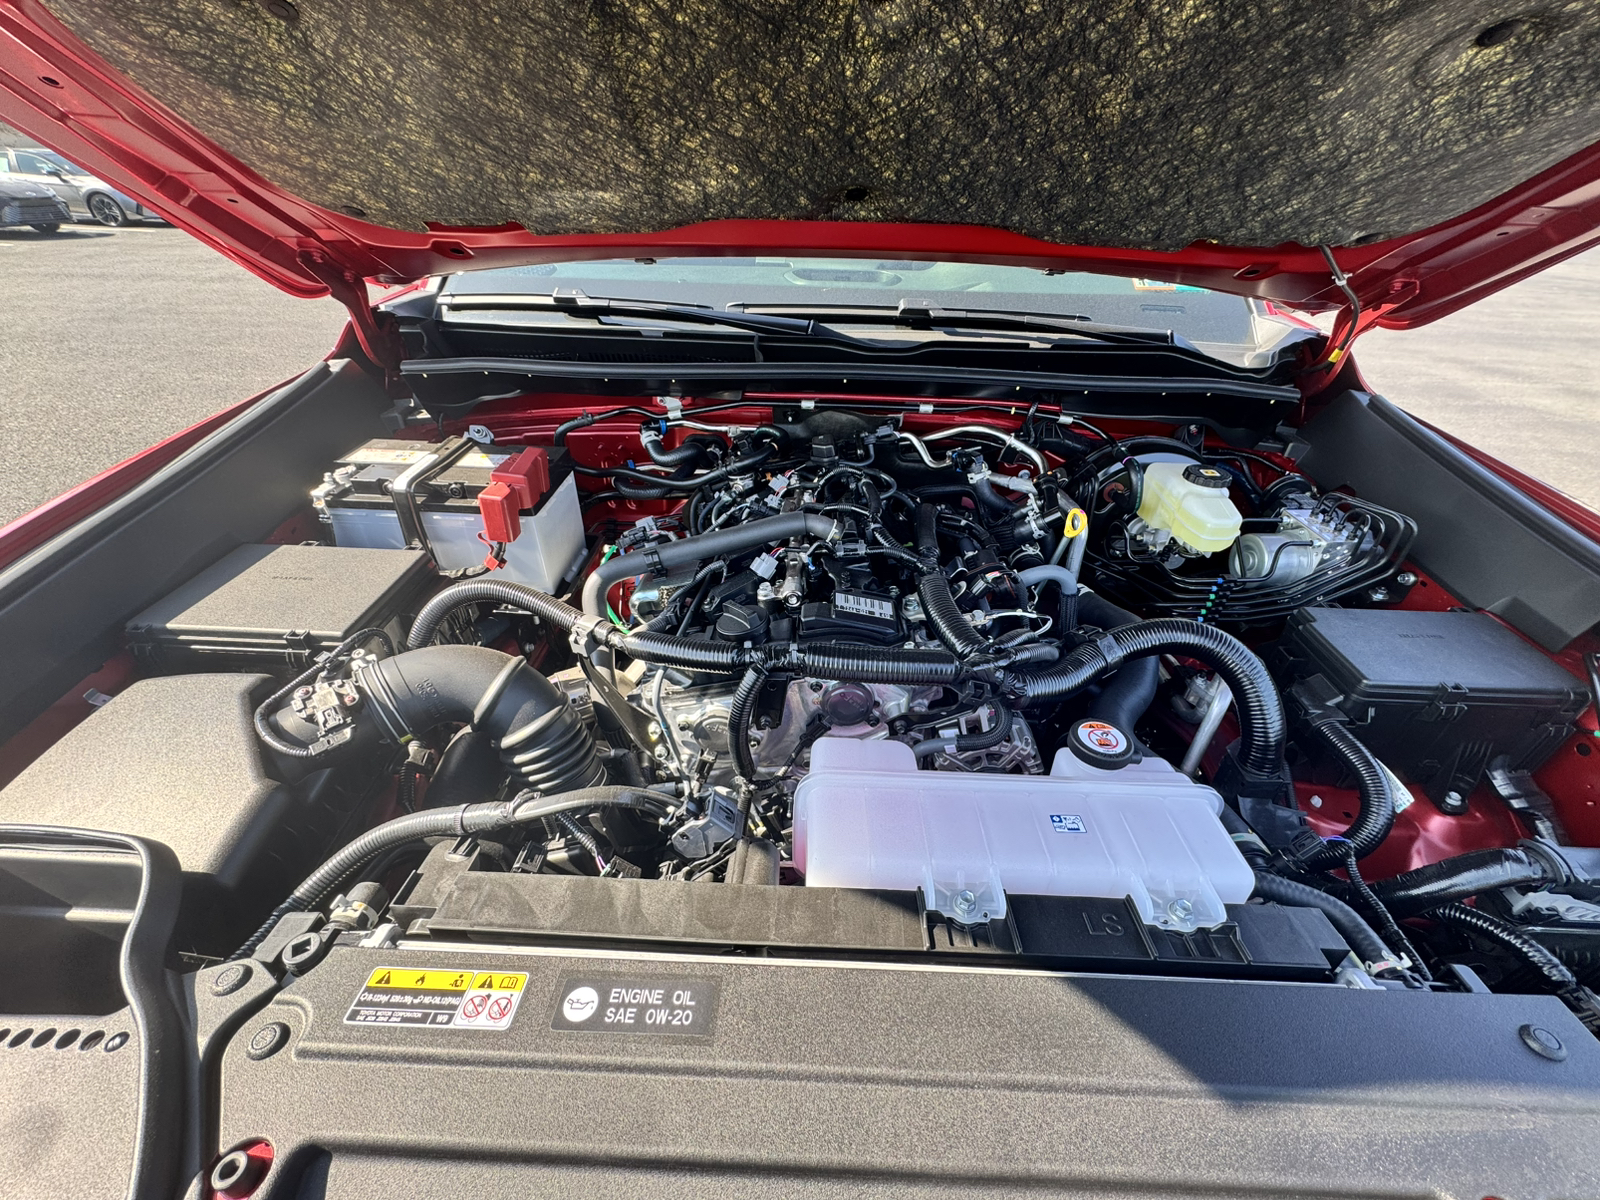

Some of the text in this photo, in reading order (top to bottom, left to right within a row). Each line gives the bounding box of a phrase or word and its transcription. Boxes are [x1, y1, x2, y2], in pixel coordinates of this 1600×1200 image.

[1082, 912, 1125, 936] LS
[609, 988, 696, 1006] ENGINE OIL
[604, 1007, 692, 1026] SAE 0W-20
